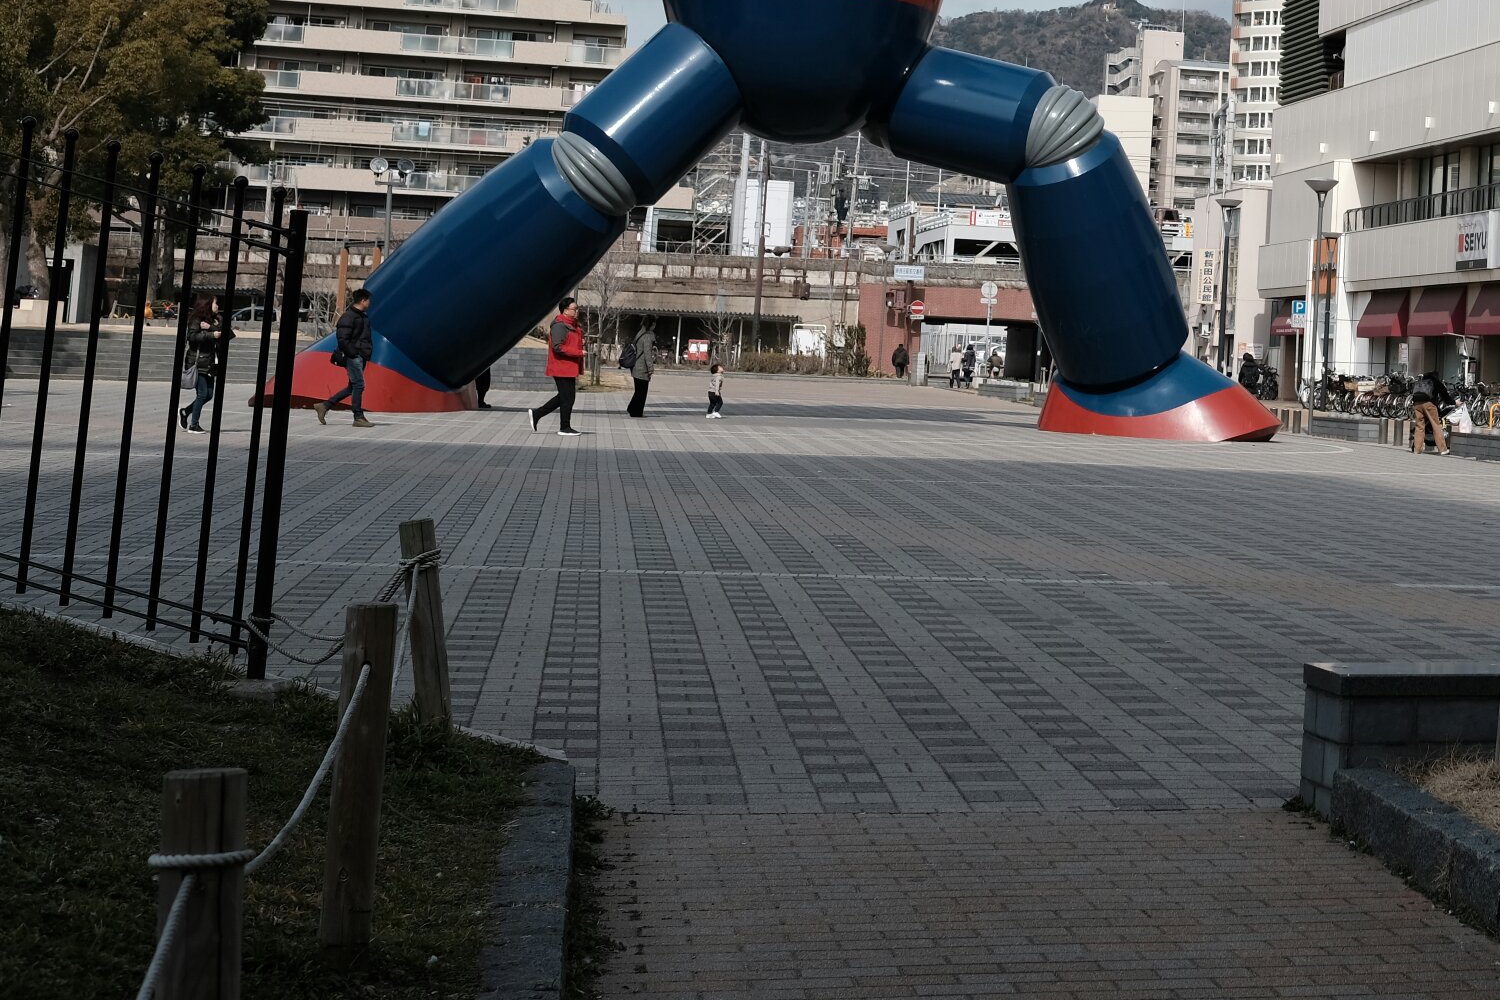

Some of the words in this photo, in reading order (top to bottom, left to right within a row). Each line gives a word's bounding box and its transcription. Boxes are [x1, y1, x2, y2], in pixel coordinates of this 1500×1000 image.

[1464, 232, 1487, 251] SEIYU
[1202, 251, 1214, 301] 新長田公民館
[1296, 303, 1304, 313] P
